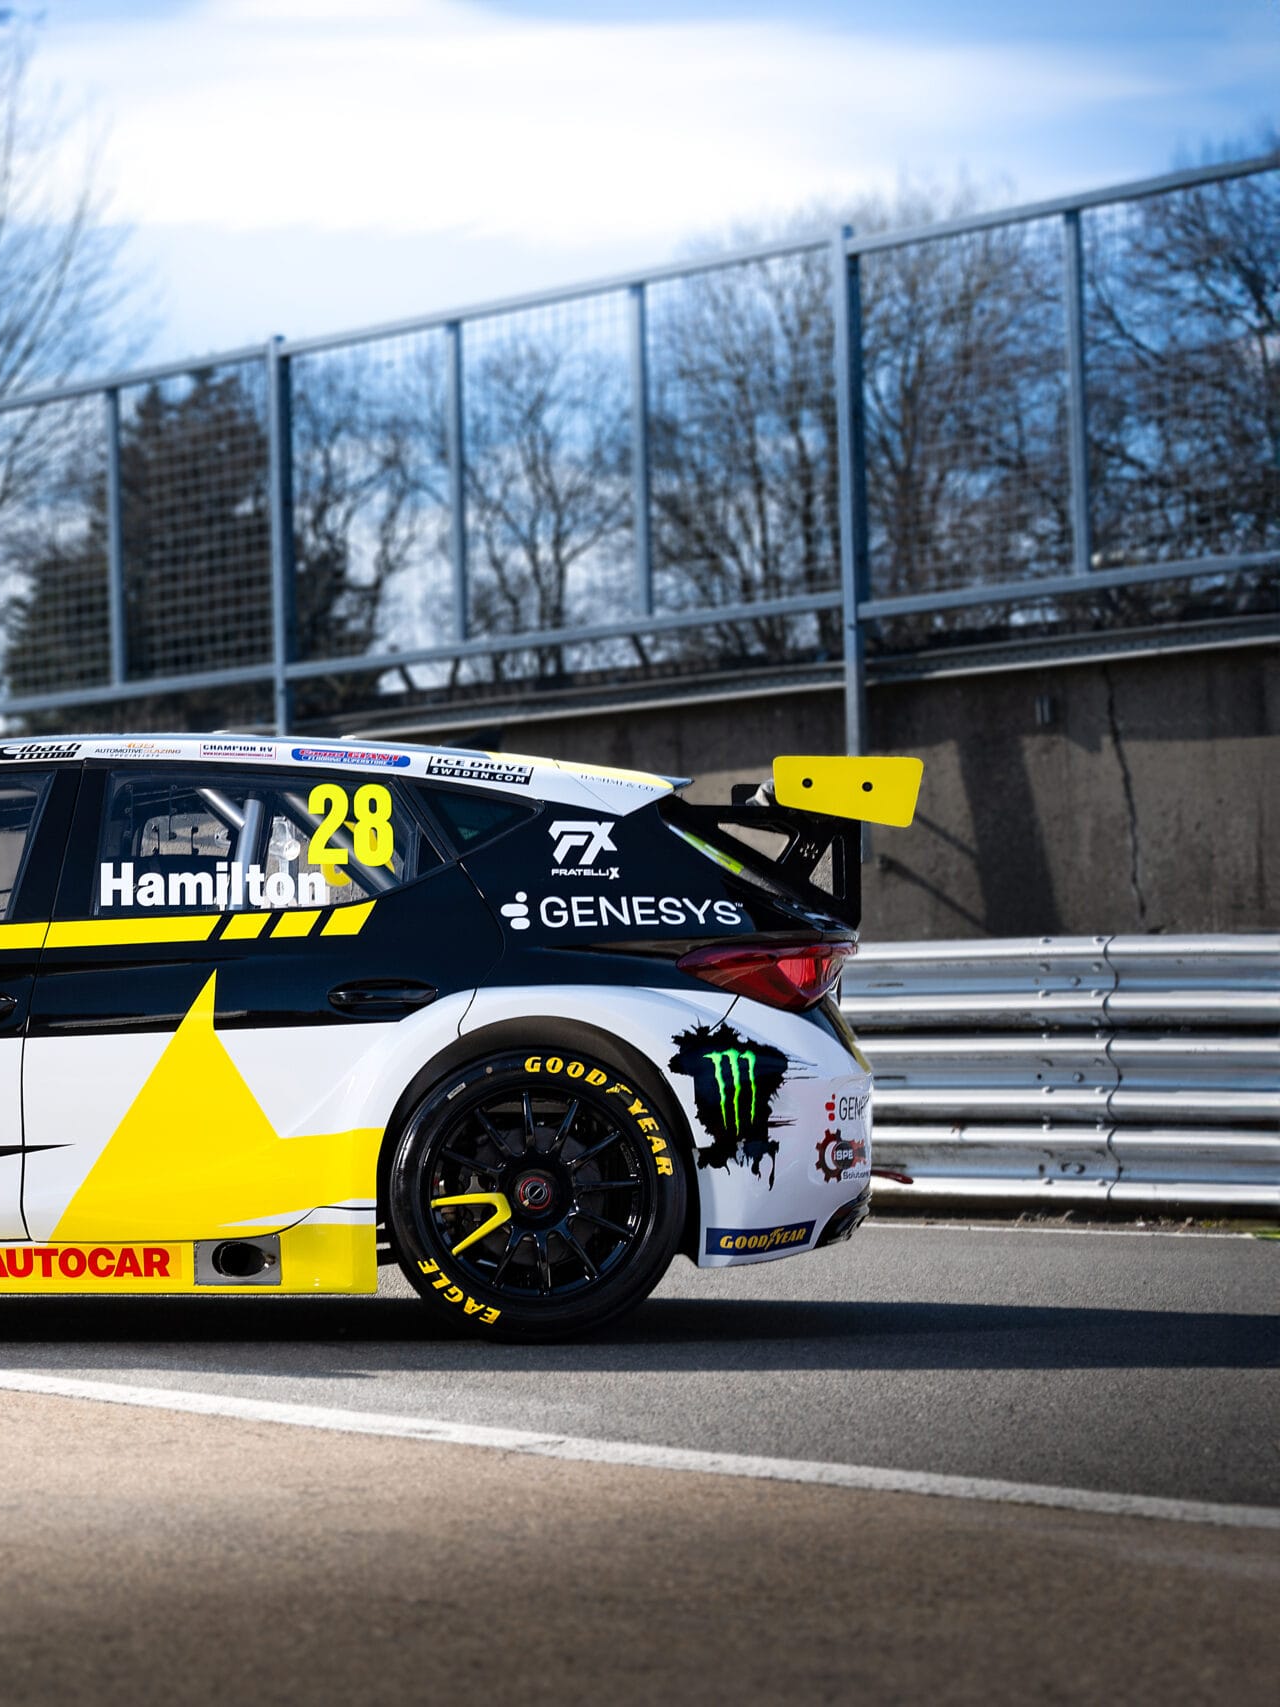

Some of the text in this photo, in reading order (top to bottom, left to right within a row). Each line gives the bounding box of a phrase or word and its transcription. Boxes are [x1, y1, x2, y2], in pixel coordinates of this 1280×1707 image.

[202, 744, 257, 752] CHAMPION
[431, 767, 526, 783] SWEDEN.COM
[436, 758, 528, 774] ICE DRIVE
[307, 783, 394, 867] 28
[100, 861, 327, 907] Hamilton
[417, 1257, 502, 1325] EAGLE
